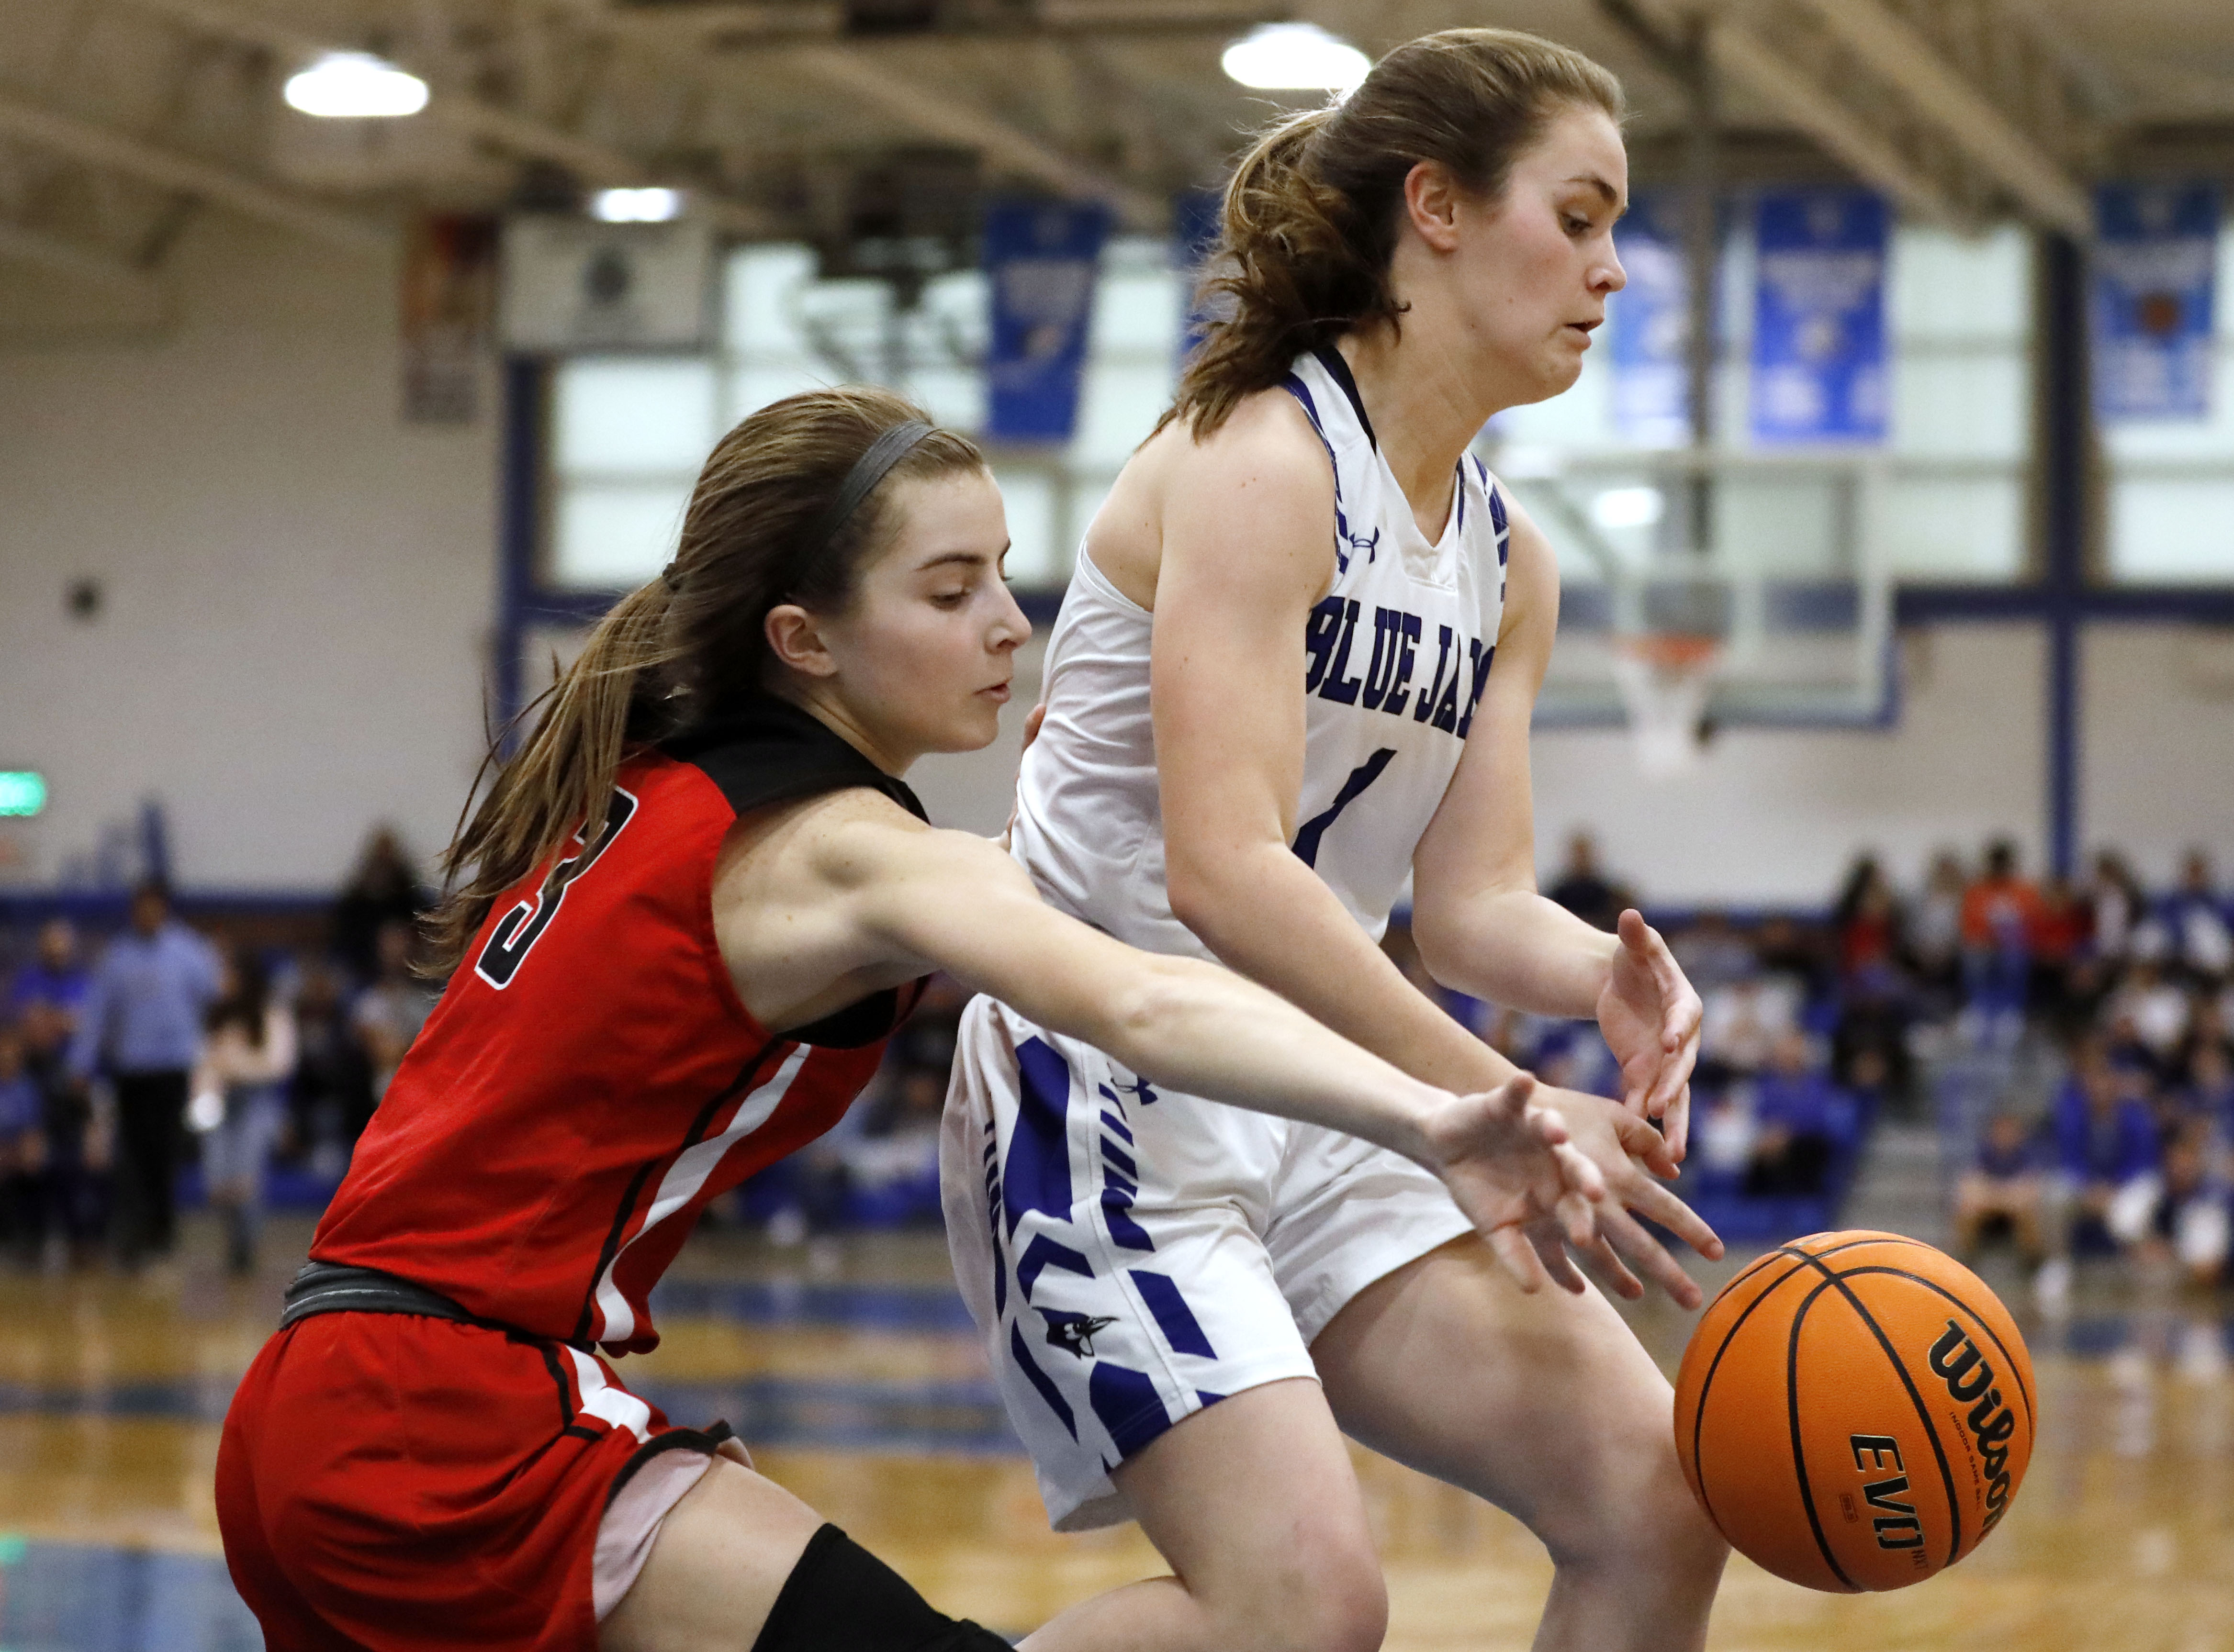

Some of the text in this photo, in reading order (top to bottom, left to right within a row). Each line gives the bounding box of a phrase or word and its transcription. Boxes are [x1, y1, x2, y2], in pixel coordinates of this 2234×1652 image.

[1306, 596, 1422, 716] BLUE
[1291, 747, 1398, 871] 1
[474, 784, 639, 990] 3
[1849, 1433, 1925, 1550] EVO
[1949, 1411, 1971, 1452] INDOOR
